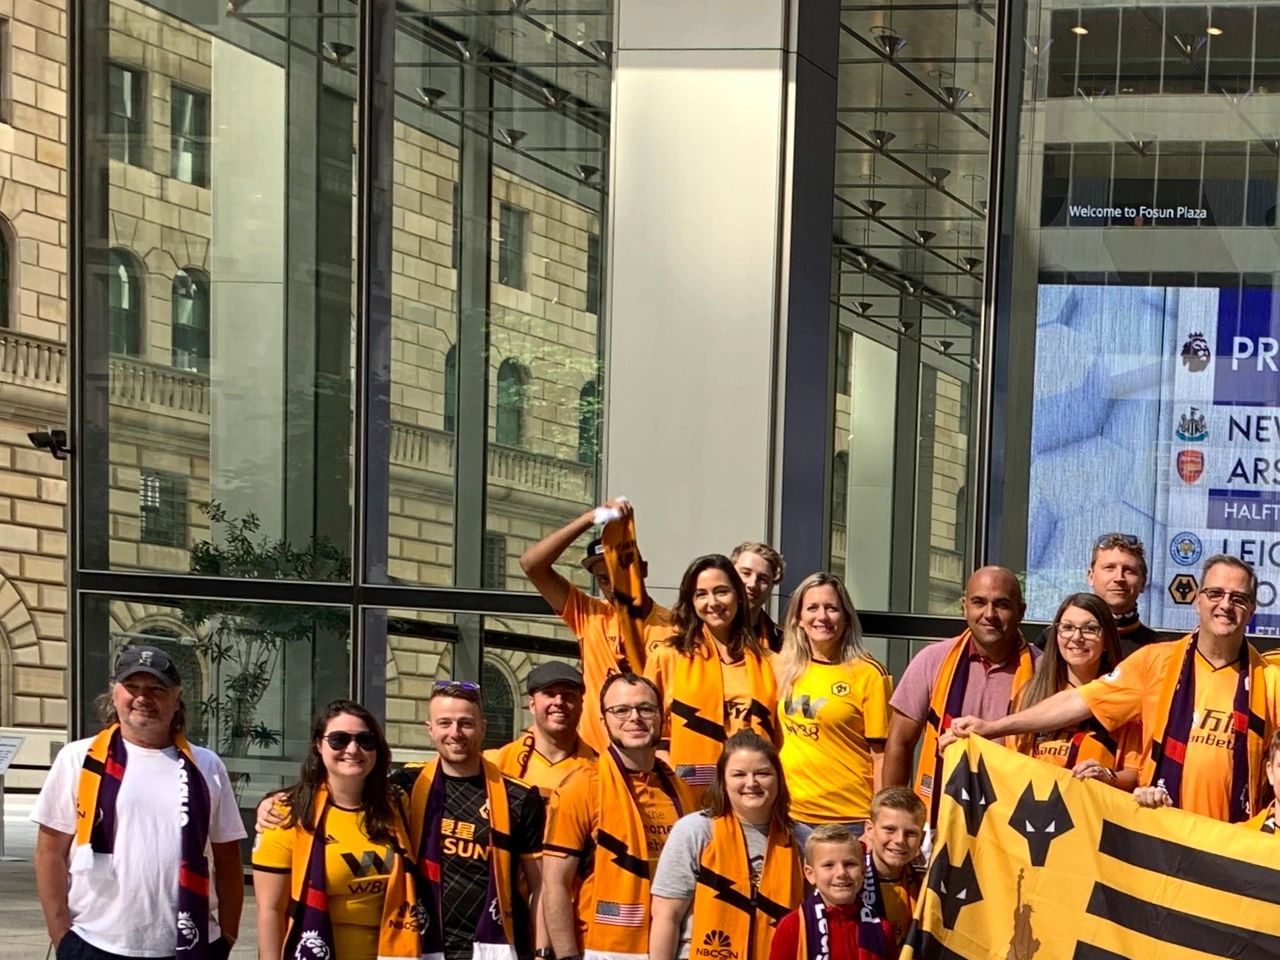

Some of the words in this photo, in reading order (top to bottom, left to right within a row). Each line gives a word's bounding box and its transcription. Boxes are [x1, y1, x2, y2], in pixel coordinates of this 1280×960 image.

[1069, 205, 1122, 218] Welcome
[1124, 206, 1136, 218] to
[1139, 206, 1174, 218] Fosun
[1176, 206, 1207, 219] Plaza
